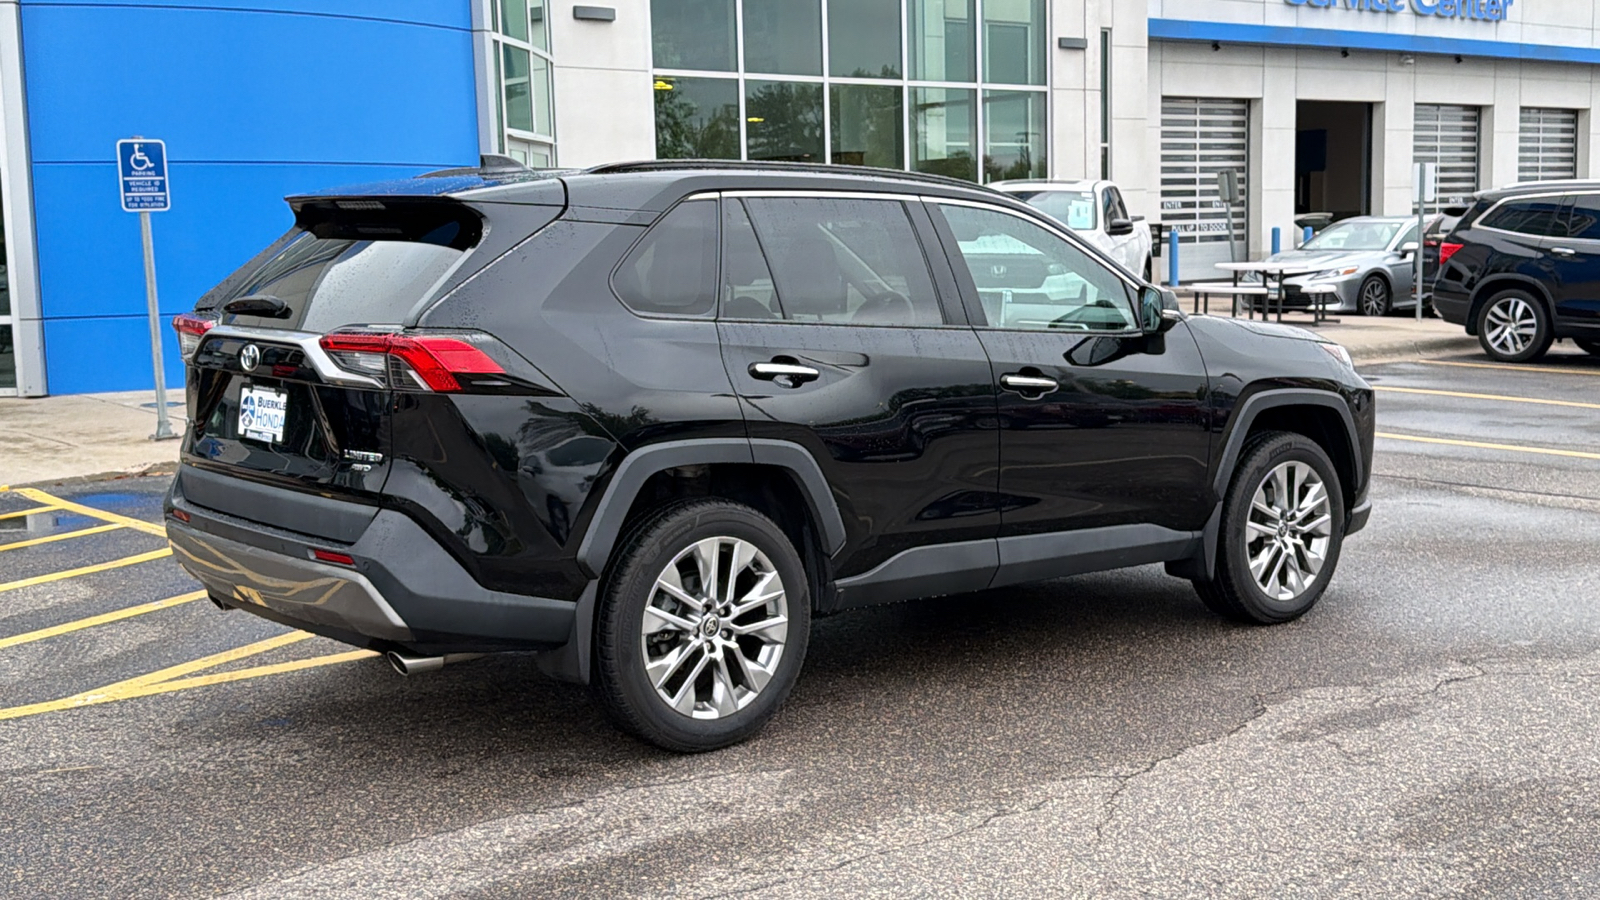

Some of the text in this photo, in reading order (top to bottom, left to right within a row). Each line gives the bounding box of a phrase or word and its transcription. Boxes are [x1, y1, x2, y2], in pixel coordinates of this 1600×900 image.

[258, 396, 287, 410] BUERKLE
[256, 408, 285, 429] HONDA
[344, 449, 383, 461] LIMITED
